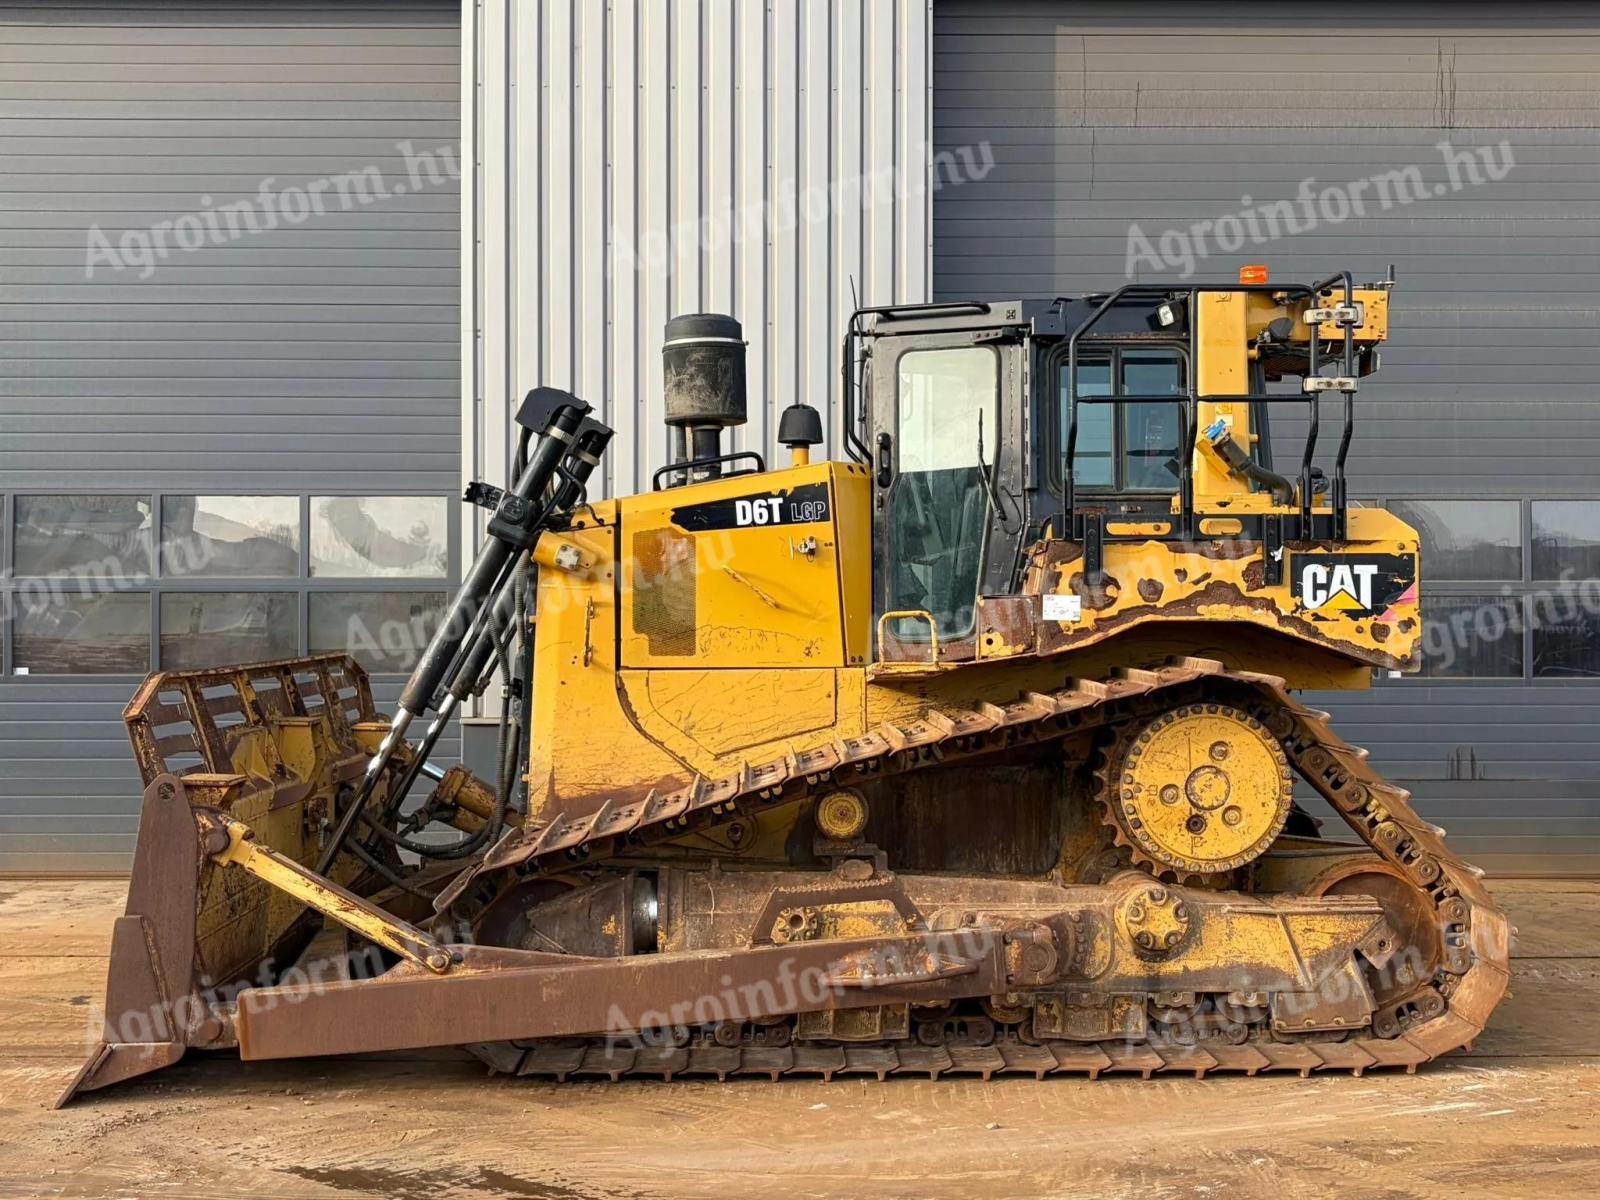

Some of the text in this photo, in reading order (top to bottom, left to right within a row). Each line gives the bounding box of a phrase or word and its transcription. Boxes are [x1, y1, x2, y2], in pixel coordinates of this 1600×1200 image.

[735, 497, 826, 526] D6T LGP
[1302, 563, 1378, 610] CAT
